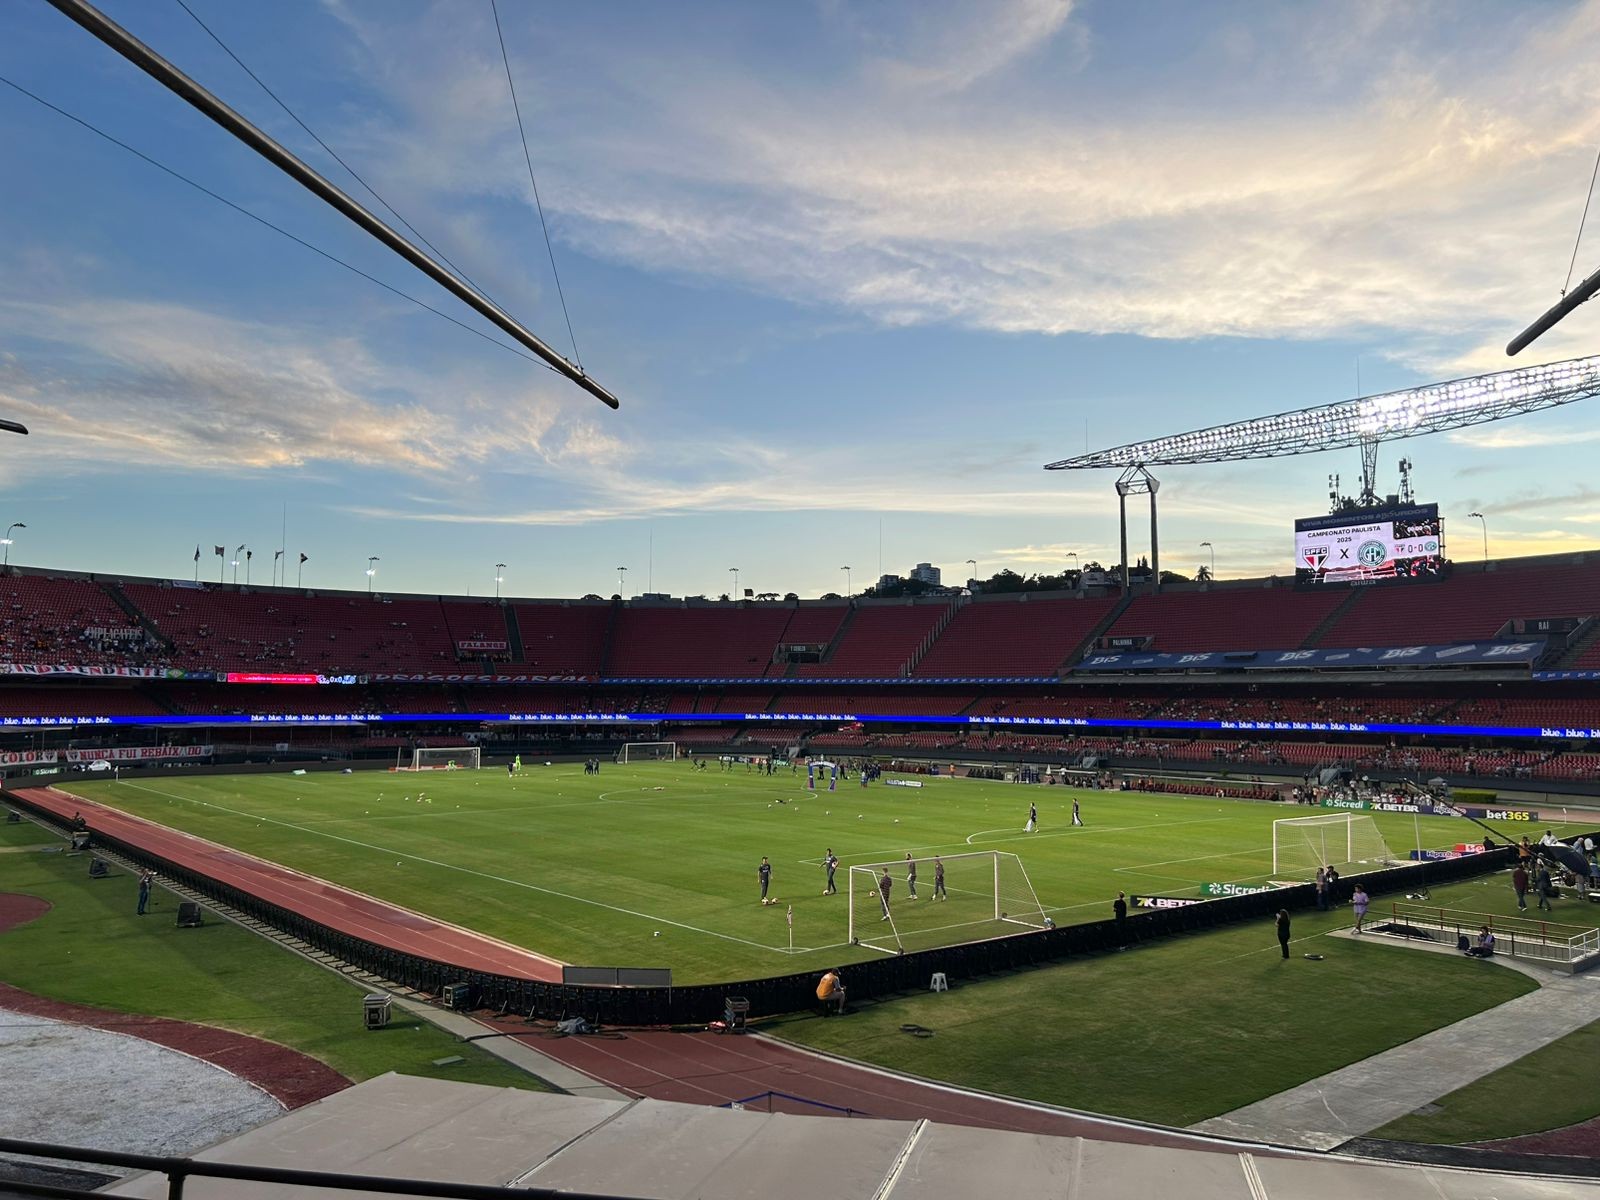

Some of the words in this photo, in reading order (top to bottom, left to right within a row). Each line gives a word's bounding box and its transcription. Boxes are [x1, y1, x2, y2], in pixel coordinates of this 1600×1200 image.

[1308, 528, 1350, 538] CAMPEONATO
[1304, 546, 1327, 555] SPFC
[14, 664, 164, 676] INDEPENDENTE
[80, 750, 113, 760] NUNCA
[118, 749, 136, 758] FUI
[1334, 799, 1364, 808] Sicredi
[1486, 810, 1529, 820] bet365
